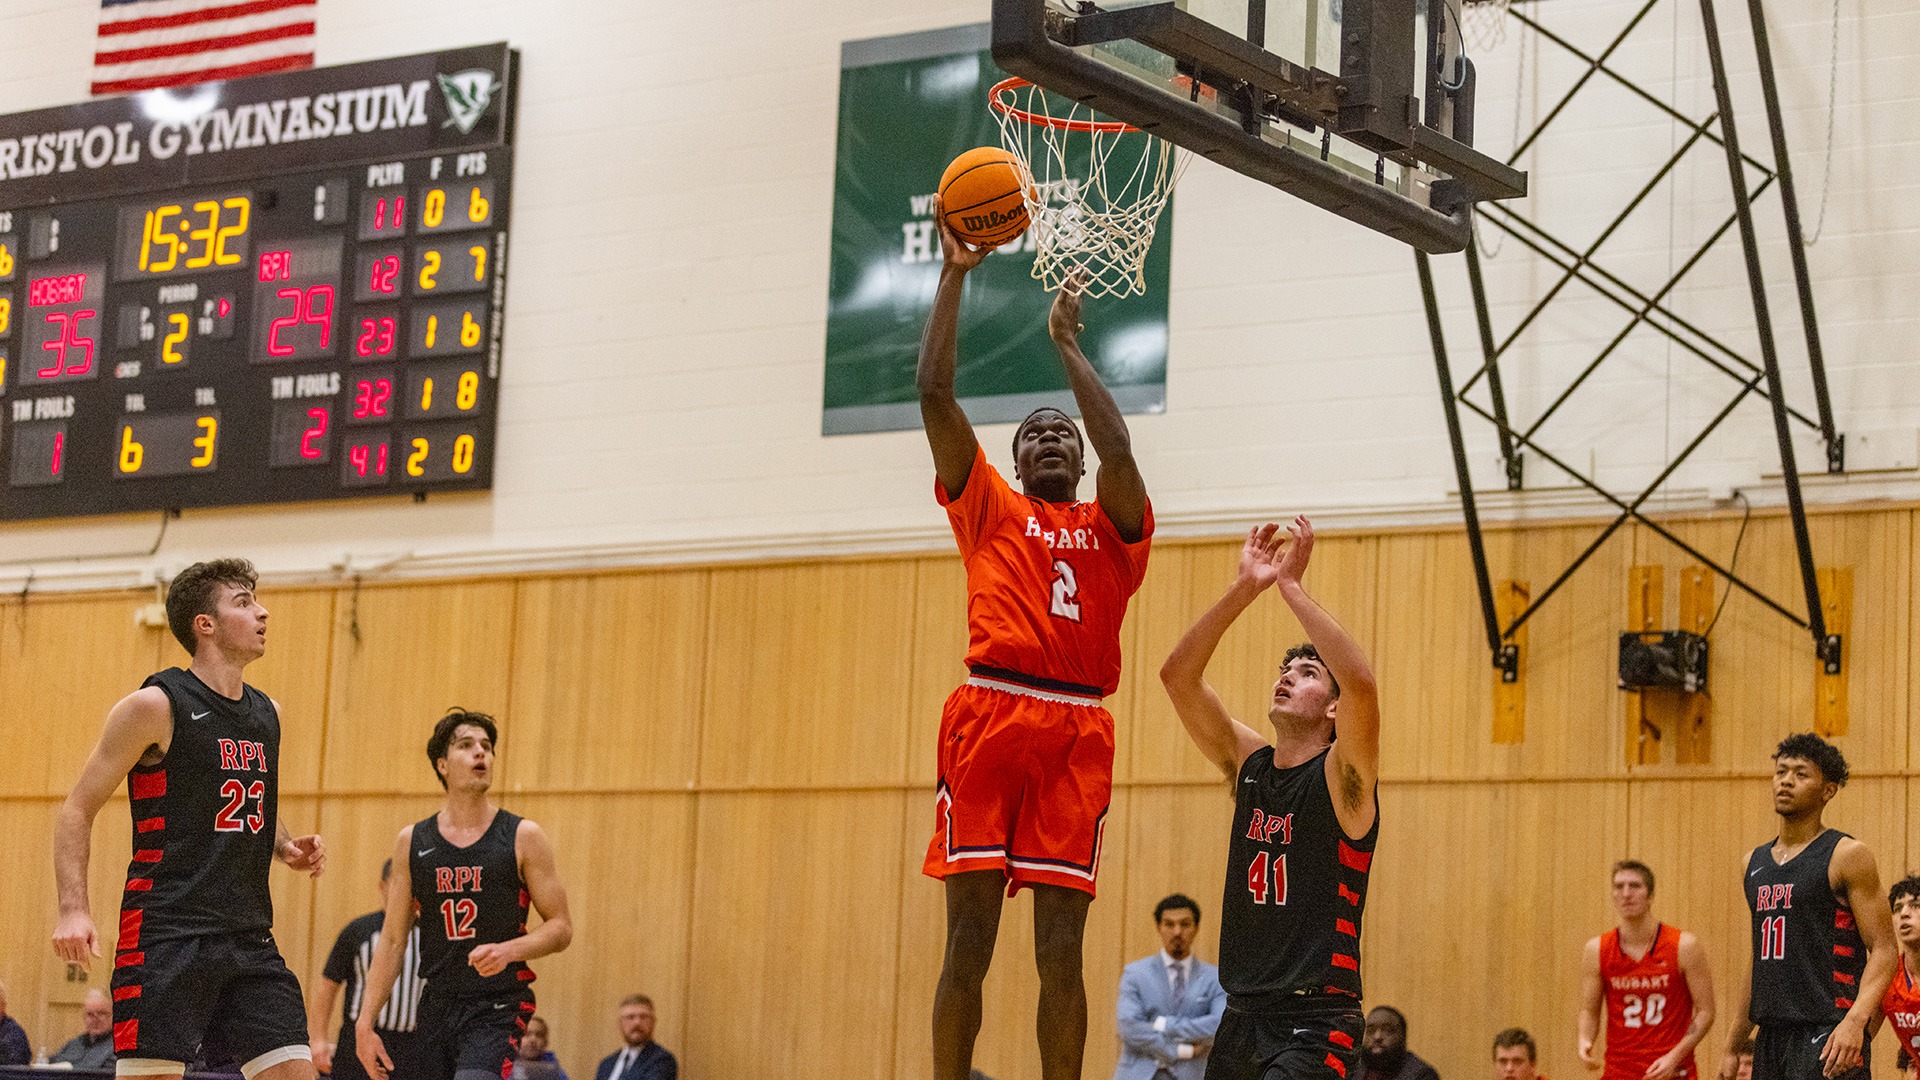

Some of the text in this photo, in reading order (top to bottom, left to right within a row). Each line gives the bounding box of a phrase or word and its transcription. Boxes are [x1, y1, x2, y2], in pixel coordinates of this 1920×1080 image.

[149, 80, 431, 159] GYMNASIUM
[430, 157, 443, 180] F
[456, 151, 487, 177] PTS
[374, 187, 489, 230] 11 0 6
[961, 202, 1028, 232] Wilson
[139, 197, 250, 272] 15:32
[259, 250, 292, 282] RPI
[371, 246, 487, 293] 12 2 7
[29, 273, 87, 307] HOBART
[162, 312, 189, 364] 2
[267, 284, 334, 356] 29
[356, 312, 480, 356] 23 1 6
[37, 309, 96, 378] 35
[353, 371, 479, 418] 32 1 8
[52, 432, 63, 474] 1
[120, 416, 217, 472] 6 3
[300, 408, 328, 459] 2
[350, 434, 475, 477] 41 2 0
[1025, 516, 1100, 550] HBAR
[1048, 557, 1082, 624] 2
[217, 738, 267, 772] RPI
[214, 778, 265, 834] 23
[1246, 808, 1294, 845] RPI
[435, 866, 483, 893] RPI
[1248, 851, 1287, 905] 41
[1756, 883, 1794, 911] RPI
[441, 898, 478, 941] 12
[1761, 915, 1786, 960] 11
[1623, 993, 1667, 1028] 20
